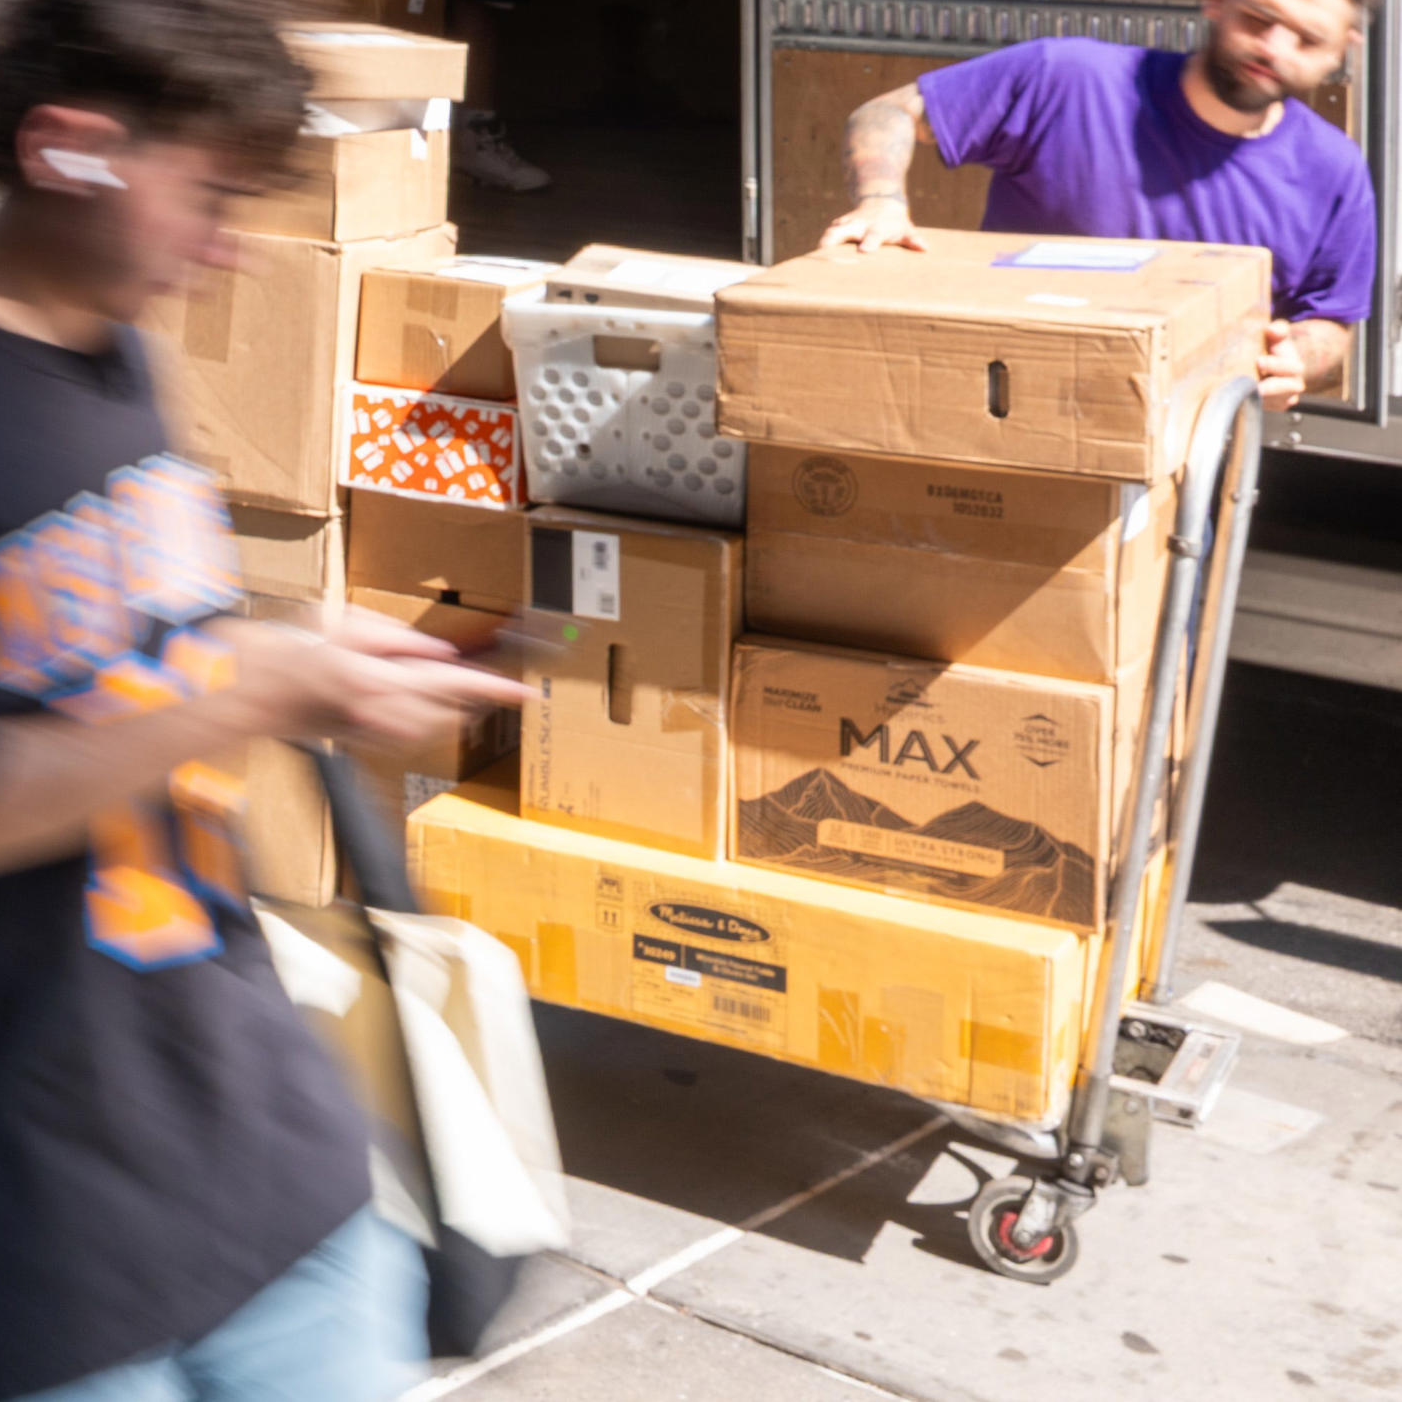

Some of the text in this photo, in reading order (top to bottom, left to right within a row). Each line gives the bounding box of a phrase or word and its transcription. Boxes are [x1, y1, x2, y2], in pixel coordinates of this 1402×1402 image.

[839, 716, 982, 782] MAX
[895, 770, 931, 789] PAPER
[936, 776, 981, 795] TOWELS
